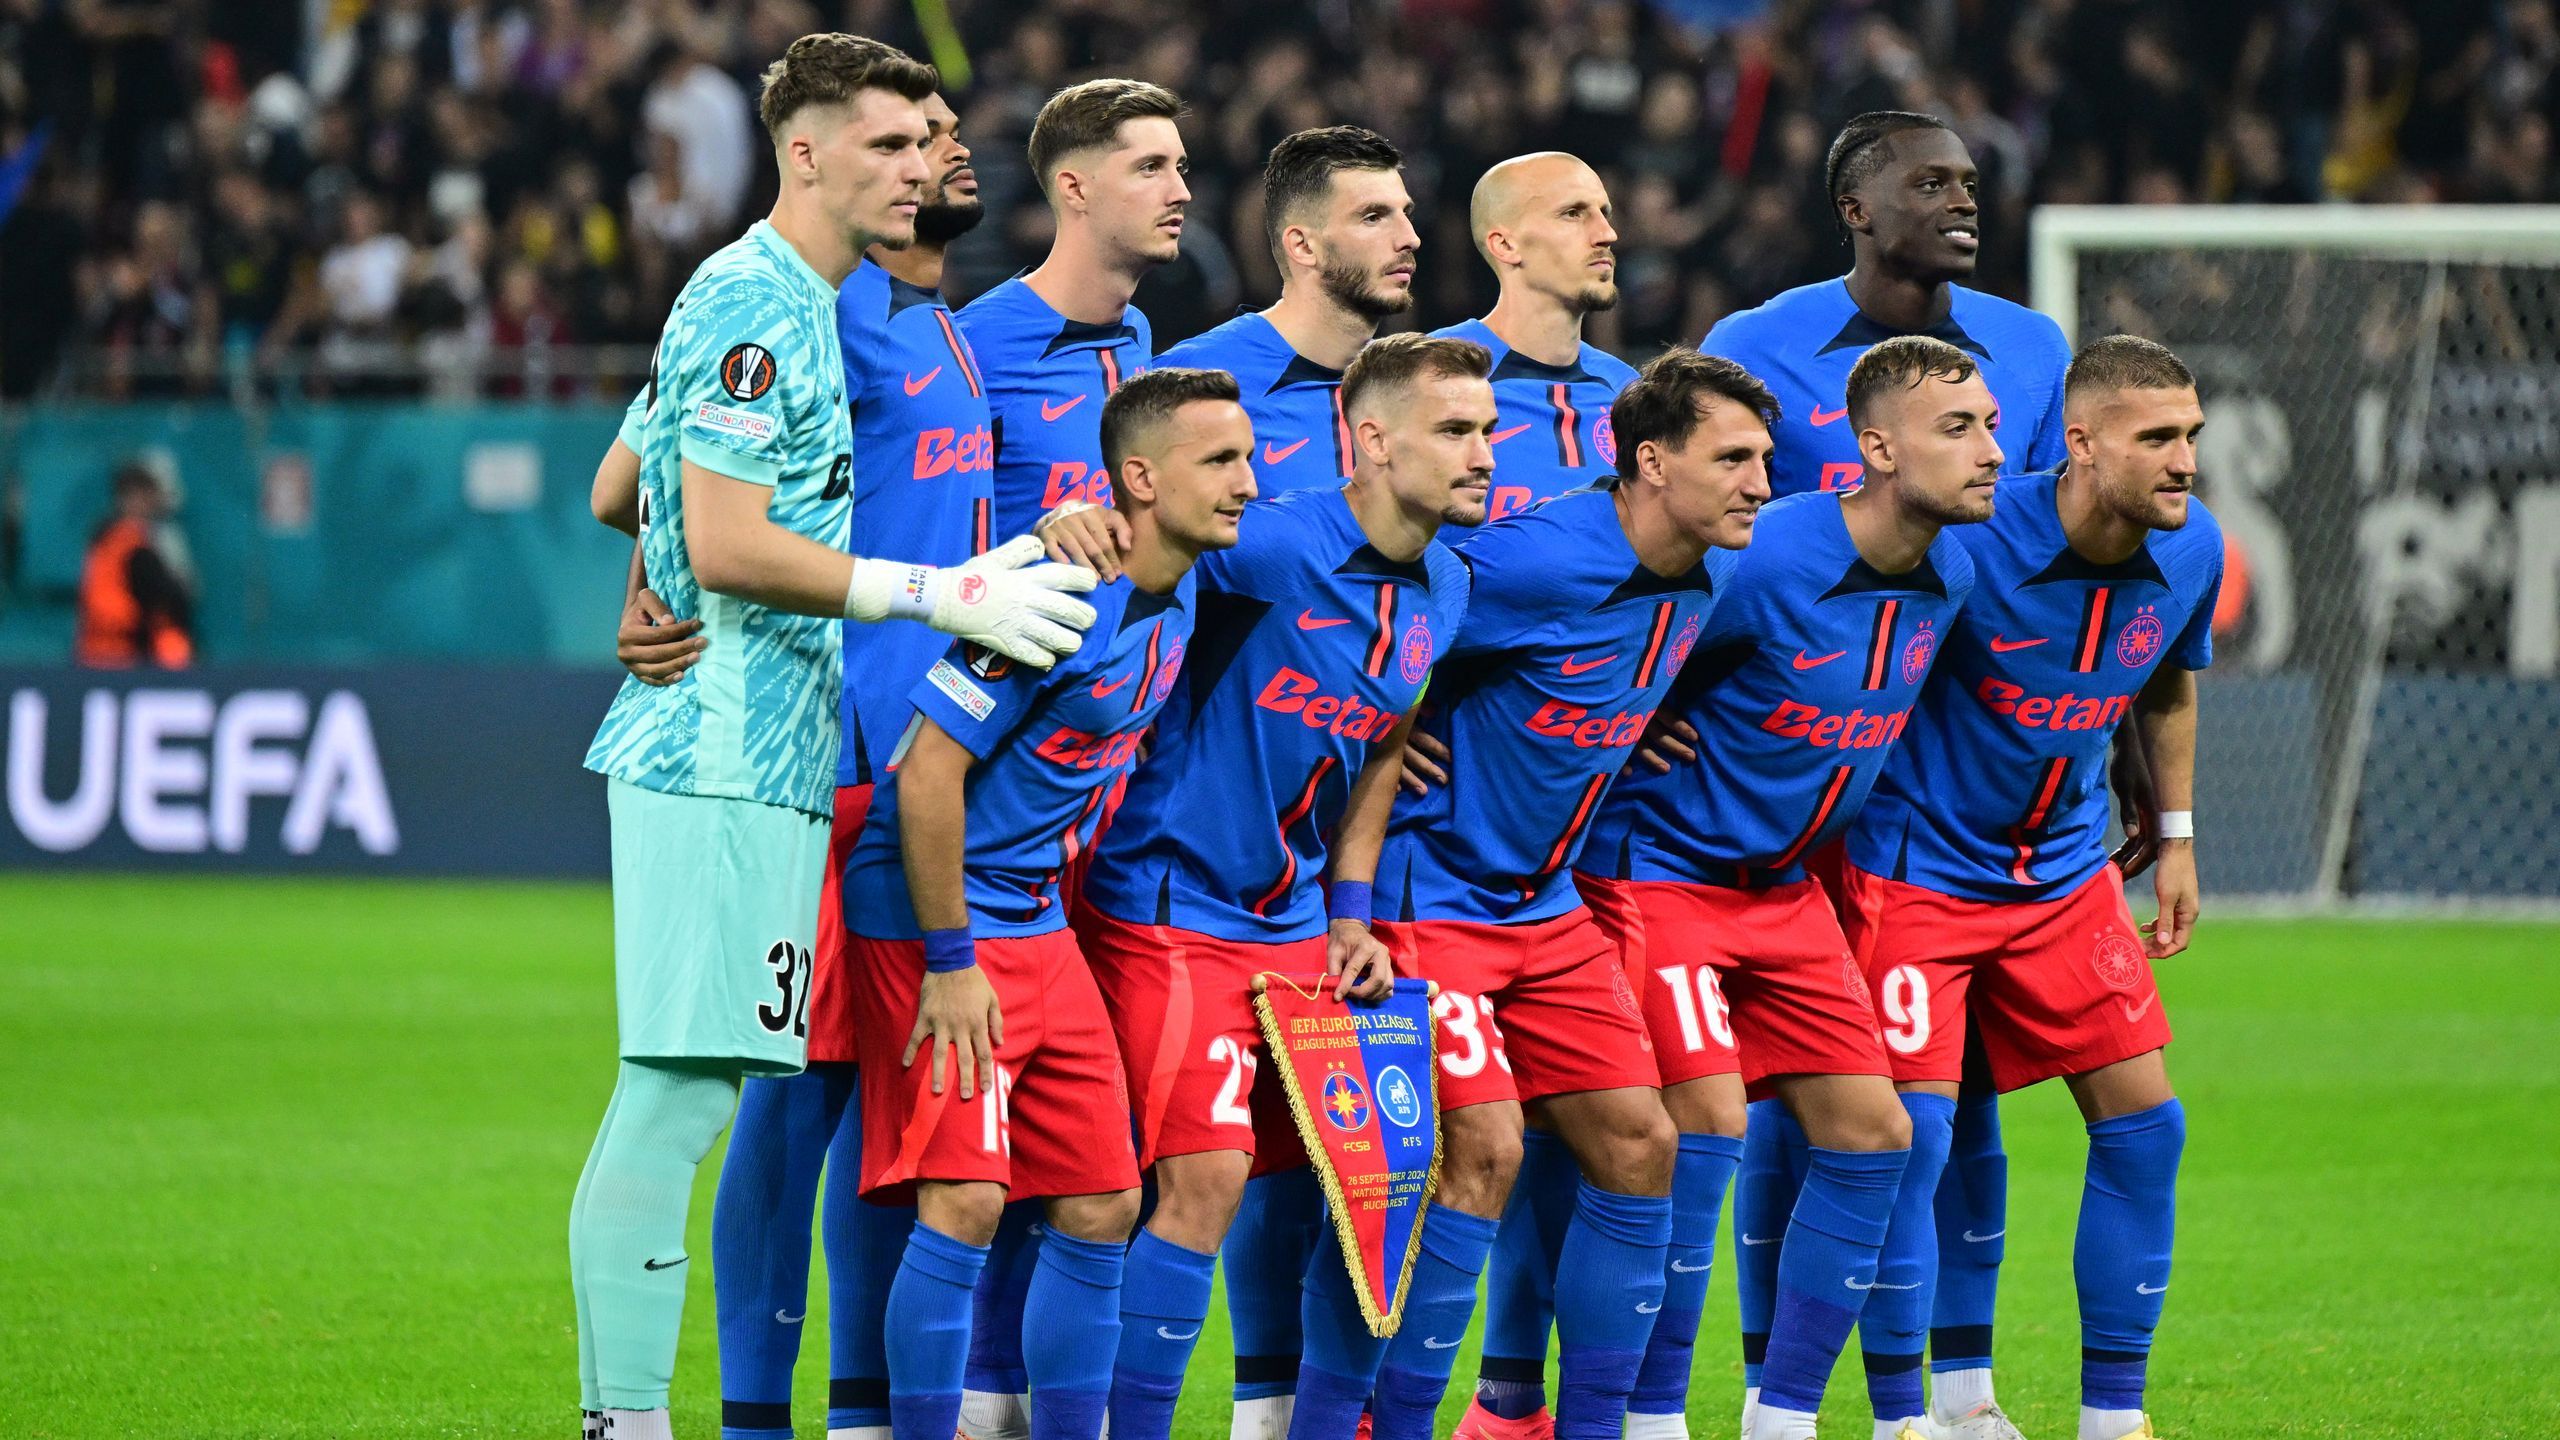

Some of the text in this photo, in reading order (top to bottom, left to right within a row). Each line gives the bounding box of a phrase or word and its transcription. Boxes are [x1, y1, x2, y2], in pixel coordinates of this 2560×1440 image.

[699, 409, 771, 433] FOUNDATION
[933, 663, 990, 714] FOUNDATION
[6, 688, 399, 855] UEFA
[1883, 965, 1930, 1054] 9
[1291, 1015, 1418, 1034] UEFA EUROPA LEAGUE
[1293, 1037, 1326, 1051] LEAGUE
[1327, 1035, 1360, 1049] PHASE
[1367, 1033, 1416, 1045] MATCHDAY
[1343, 1140, 1371, 1153] FCSB
[1402, 1136, 1422, 1148] RFS
[1347, 1170, 1426, 1186] 26 SEPTEMBER 2024
[1352, 1183, 1421, 1199] NATIONAL ARENA
[1363, 1197, 1409, 1210] BUCHAREST
